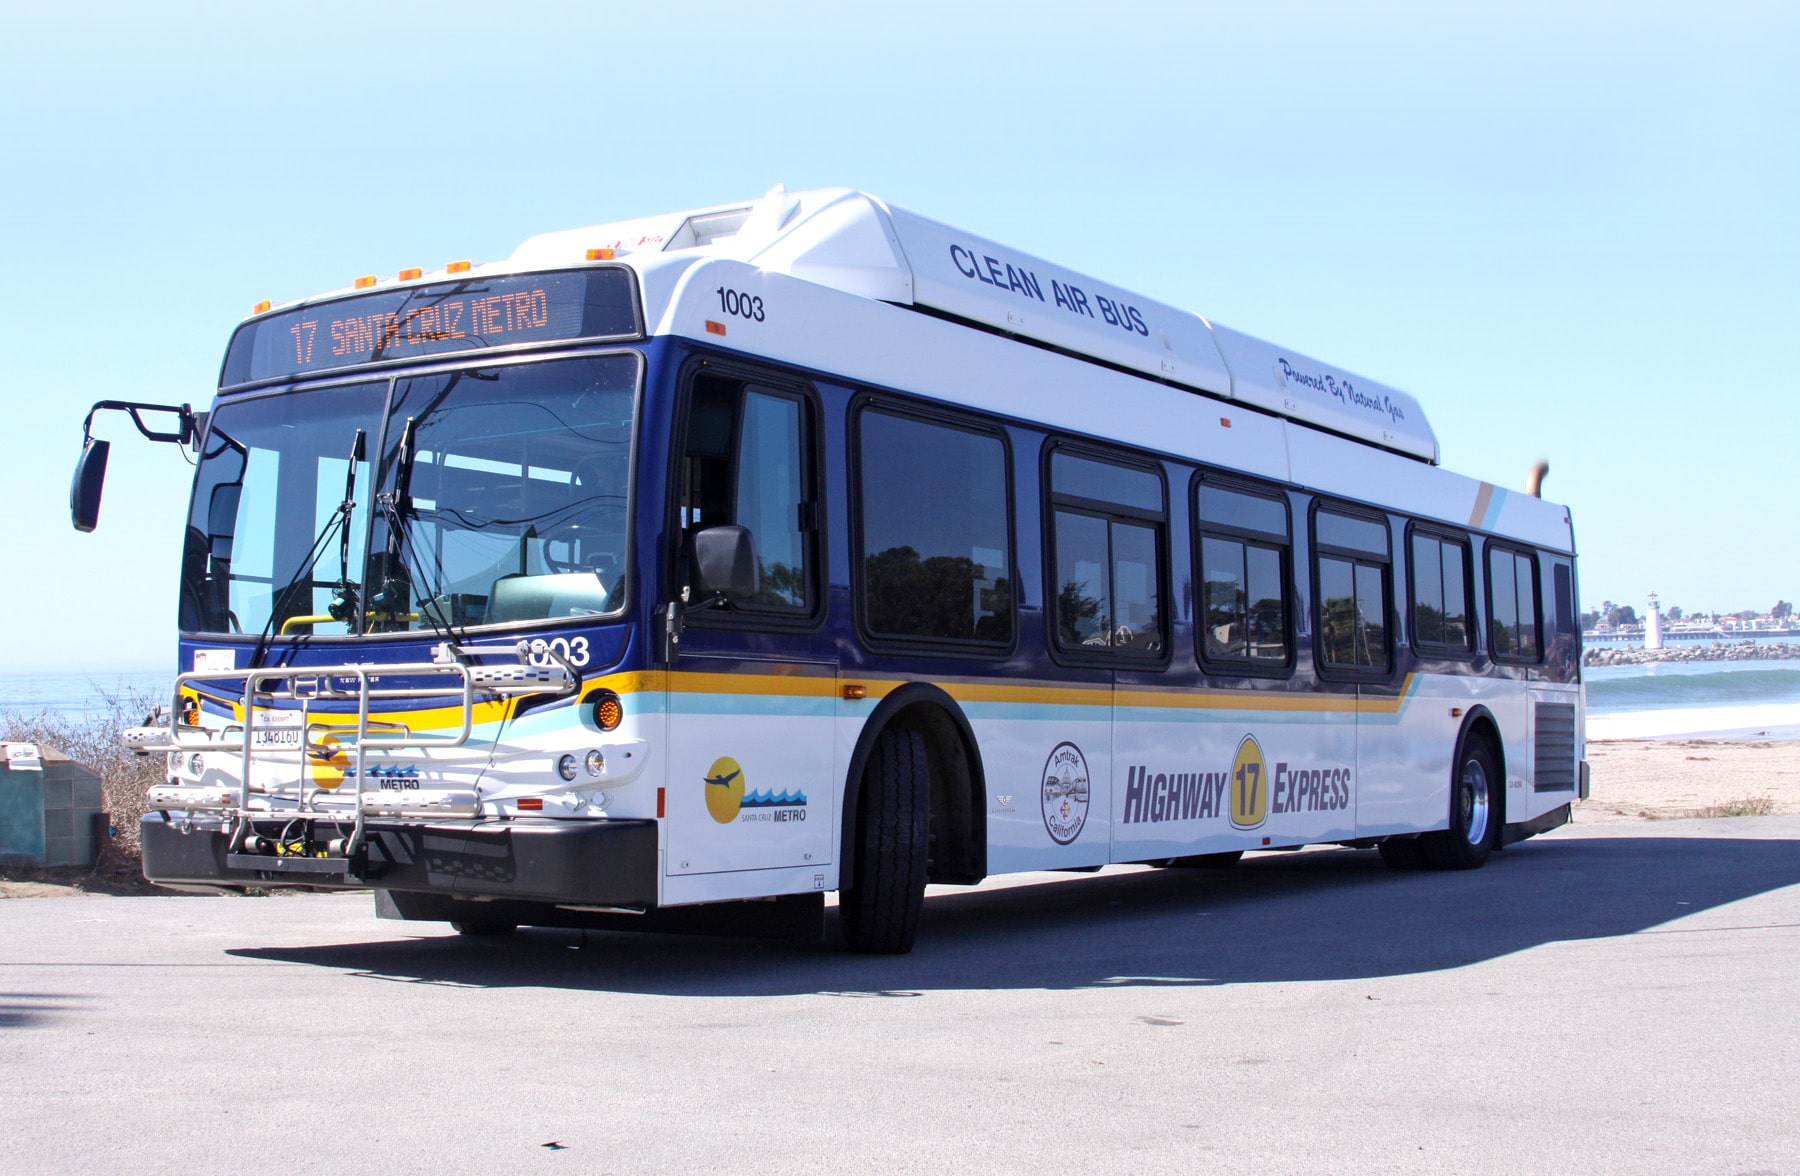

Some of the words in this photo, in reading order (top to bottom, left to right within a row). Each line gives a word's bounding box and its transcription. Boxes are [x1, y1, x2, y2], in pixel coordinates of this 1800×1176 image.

[716, 286, 765, 322] 1003
[949, 244, 1045, 302] CLEAN
[1051, 279, 1095, 318] AIR
[1095, 295, 1149, 337] BUS
[290, 320, 317, 364] 17
[331, 312, 400, 355] SANTA
[406, 301, 466, 344] CRUZ
[471, 289, 547, 336] METRO
[1278, 357, 1327, 392] Powered
[1325, 375, 1346, 405] By
[1343, 380, 1384, 413] Natural
[1384, 396, 1405, 423] Gas
[524, 636, 590, 667] 003
[1054, 750, 1080, 768] Amtrak
[380, 779, 420, 791] METRO
[1123, 765, 1228, 824] HIGHWAY
[1236, 763, 1260, 817] 17
[1272, 762, 1351, 814] EXPRESS
[741, 814, 758, 823] SANTA
[758, 813, 772, 822] CRUZ
[774, 809, 806, 823] METRO
[1049, 815, 1081, 838] California
